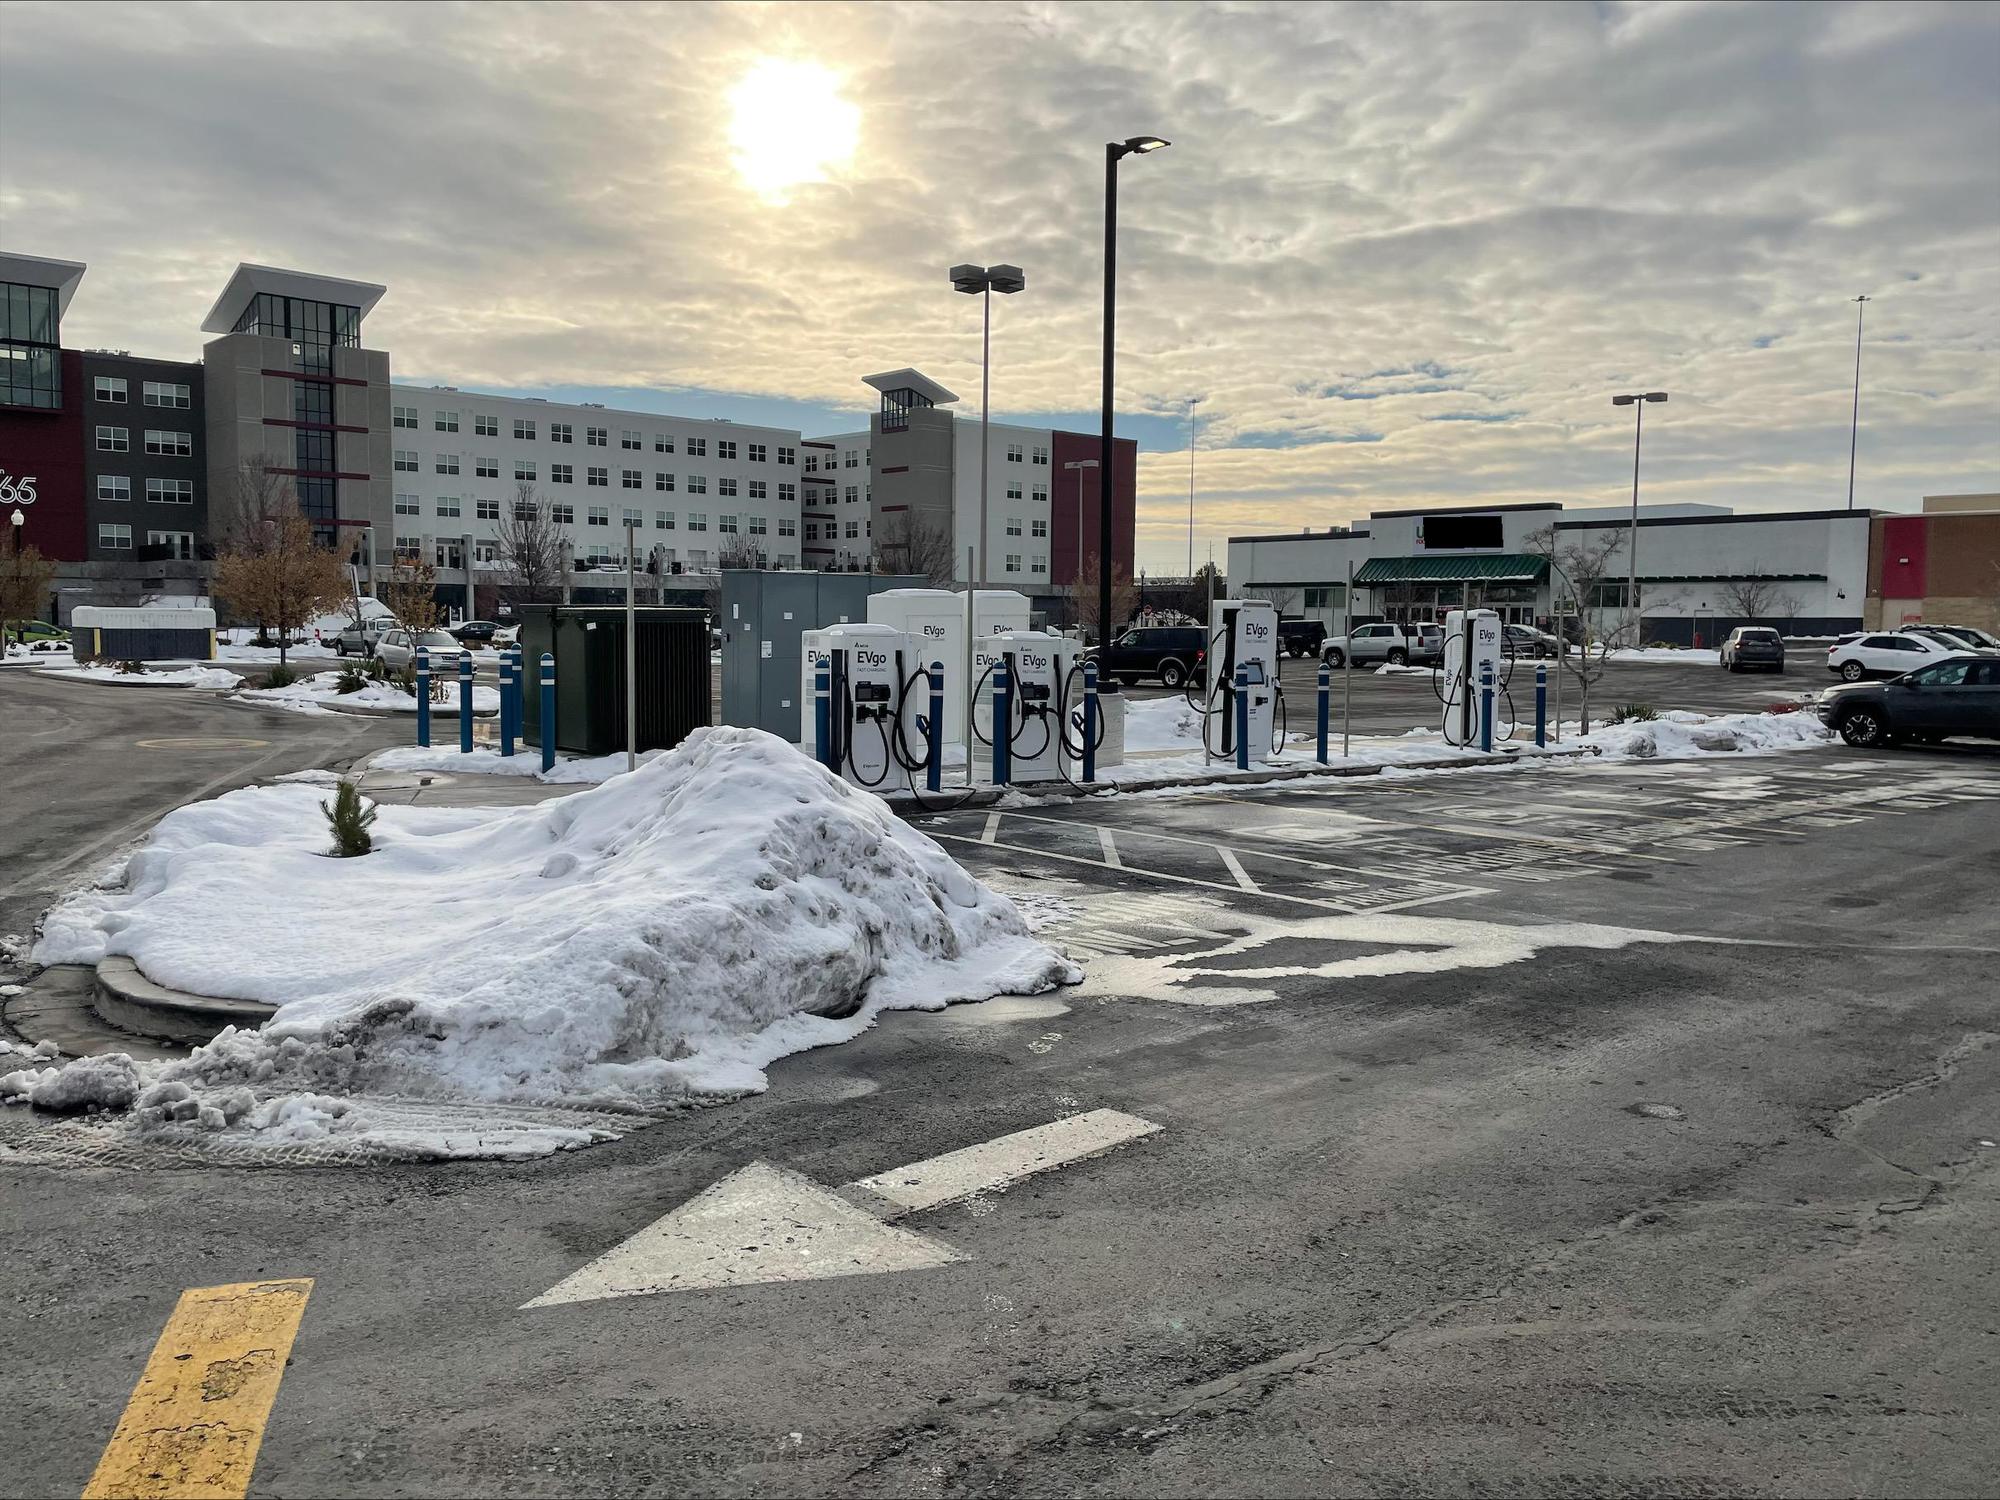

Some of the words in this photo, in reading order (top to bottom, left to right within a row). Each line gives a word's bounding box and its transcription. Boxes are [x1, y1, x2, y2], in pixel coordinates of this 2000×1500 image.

[924, 625, 945, 637] EVgo
[1246, 623, 1268, 638] EVgo
[1479, 629, 1495, 642] EVgo
[857, 651, 887, 667] EVgo
[1023, 655, 1047, 669] EVgo
